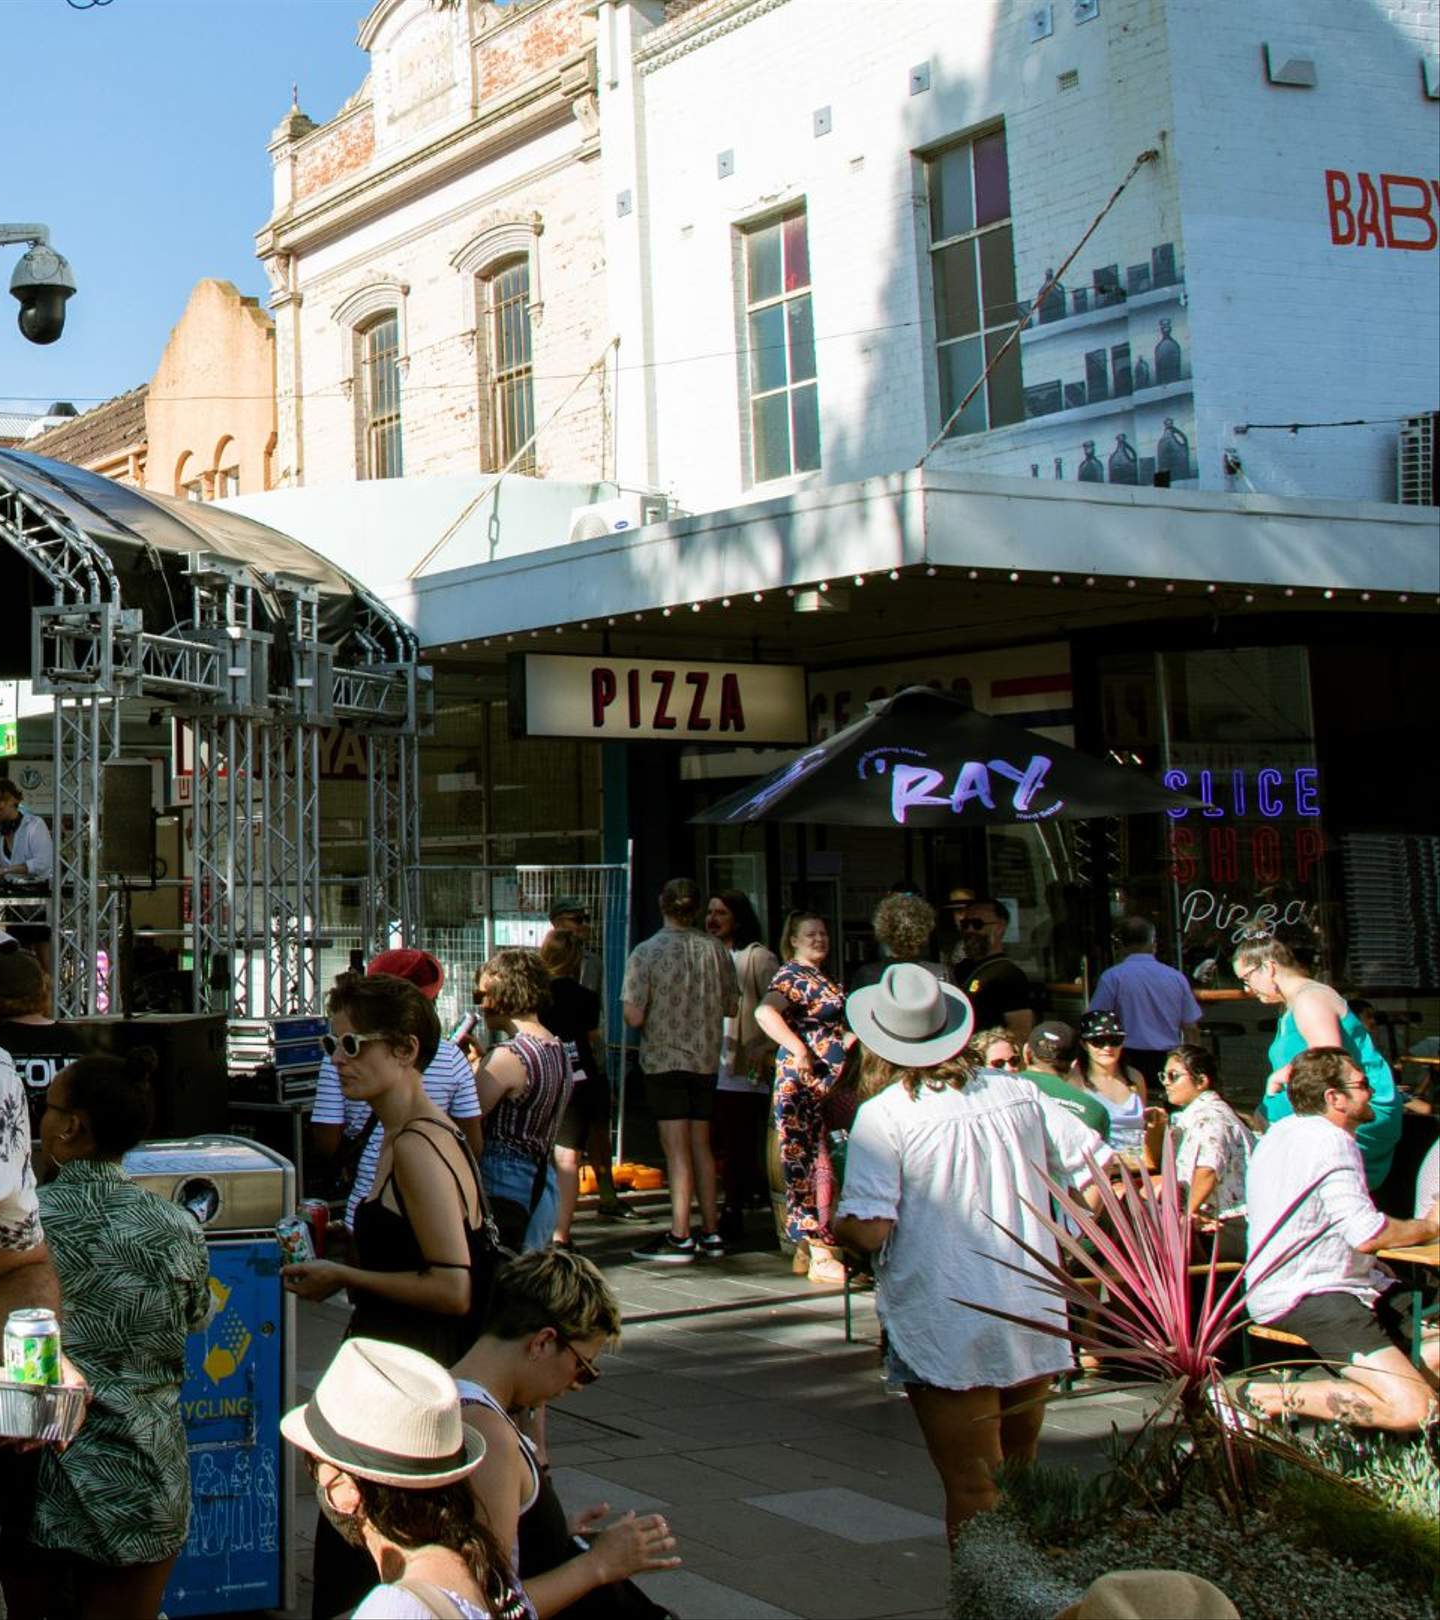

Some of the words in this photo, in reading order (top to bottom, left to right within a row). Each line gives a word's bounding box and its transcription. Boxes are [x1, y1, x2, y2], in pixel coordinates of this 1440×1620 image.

[592, 668, 745, 732] PIZZA
[892, 755, 1053, 824] RAY
[1163, 767, 1321, 818] SLICE
[1167, 825, 1326, 885] SHOP
[1182, 889, 1308, 943] Pizza
